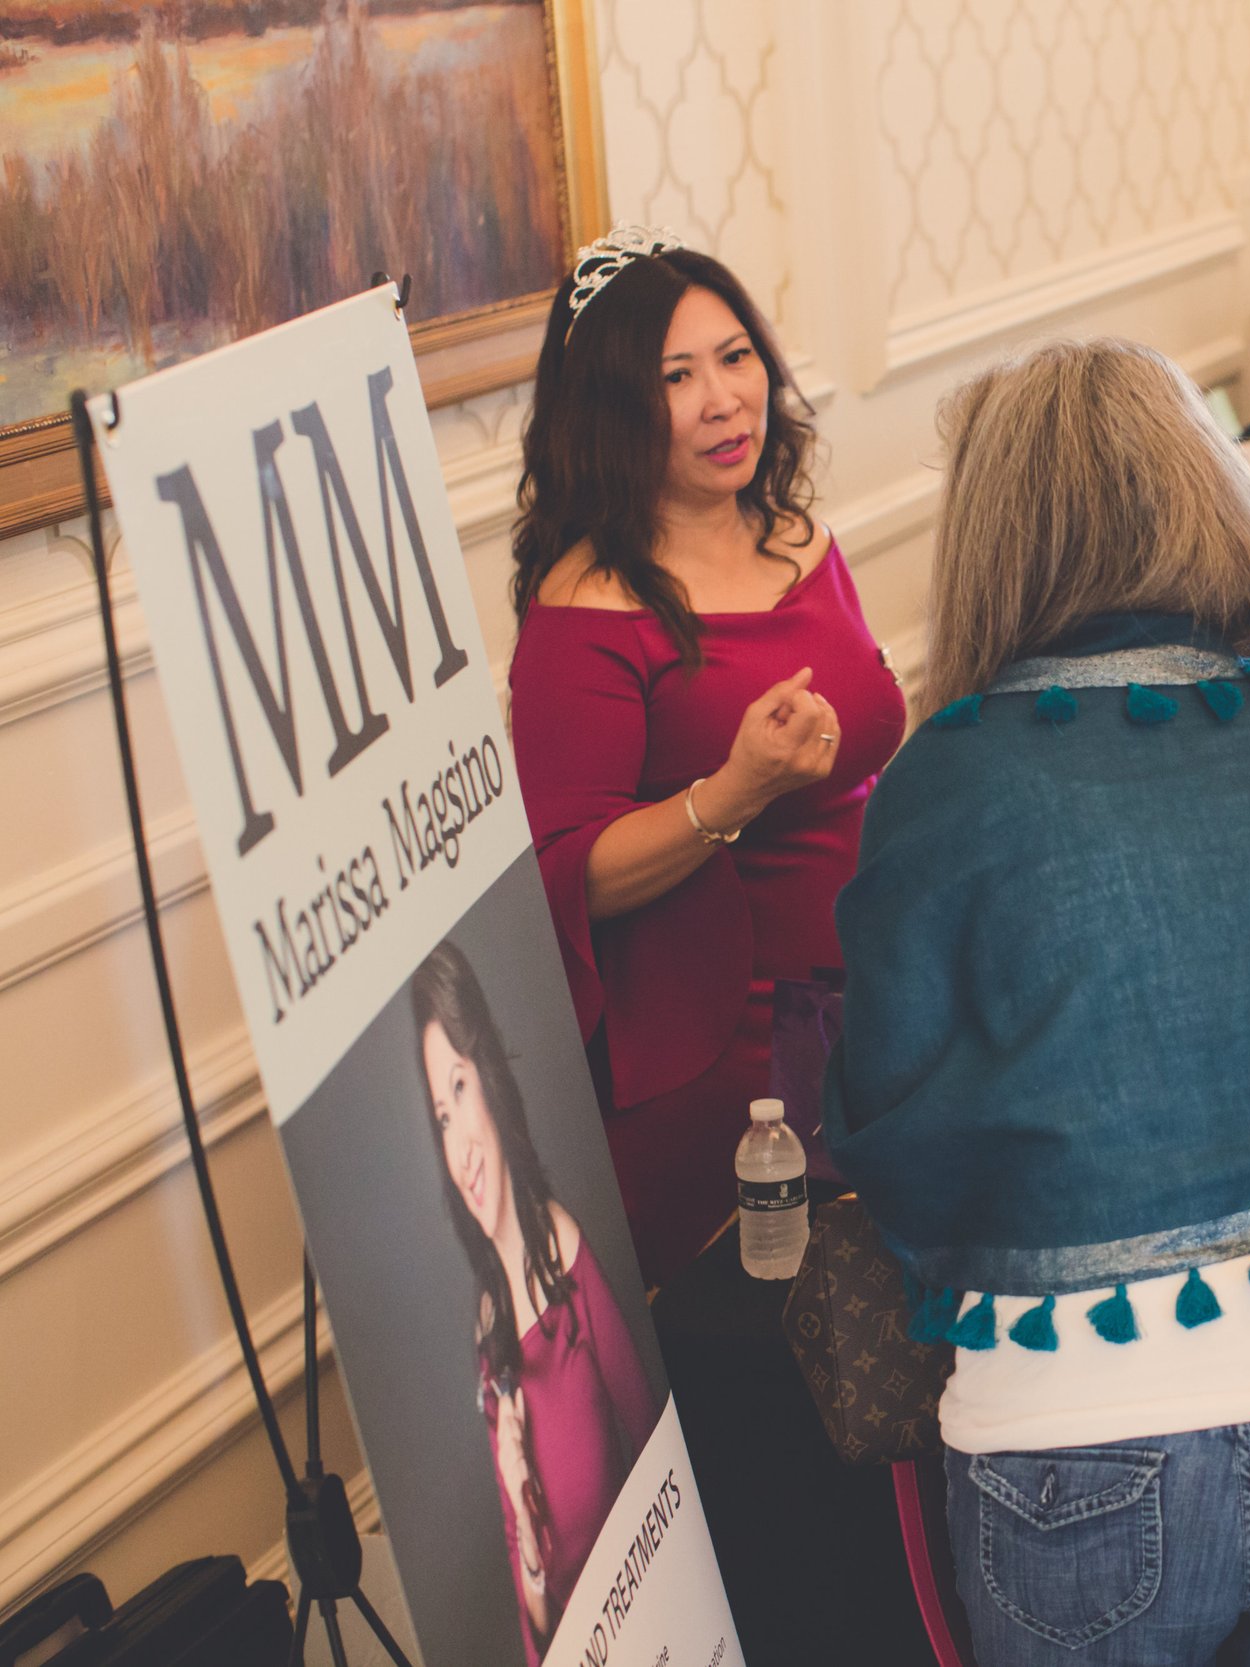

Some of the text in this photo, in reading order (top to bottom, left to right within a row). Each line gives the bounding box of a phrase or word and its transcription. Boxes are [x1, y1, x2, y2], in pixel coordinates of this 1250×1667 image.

[157, 366, 468, 857] MM
[254, 733, 503, 1024] Marissa Magsino
[579, 1468, 681, 1667] ND TREATMENTS
